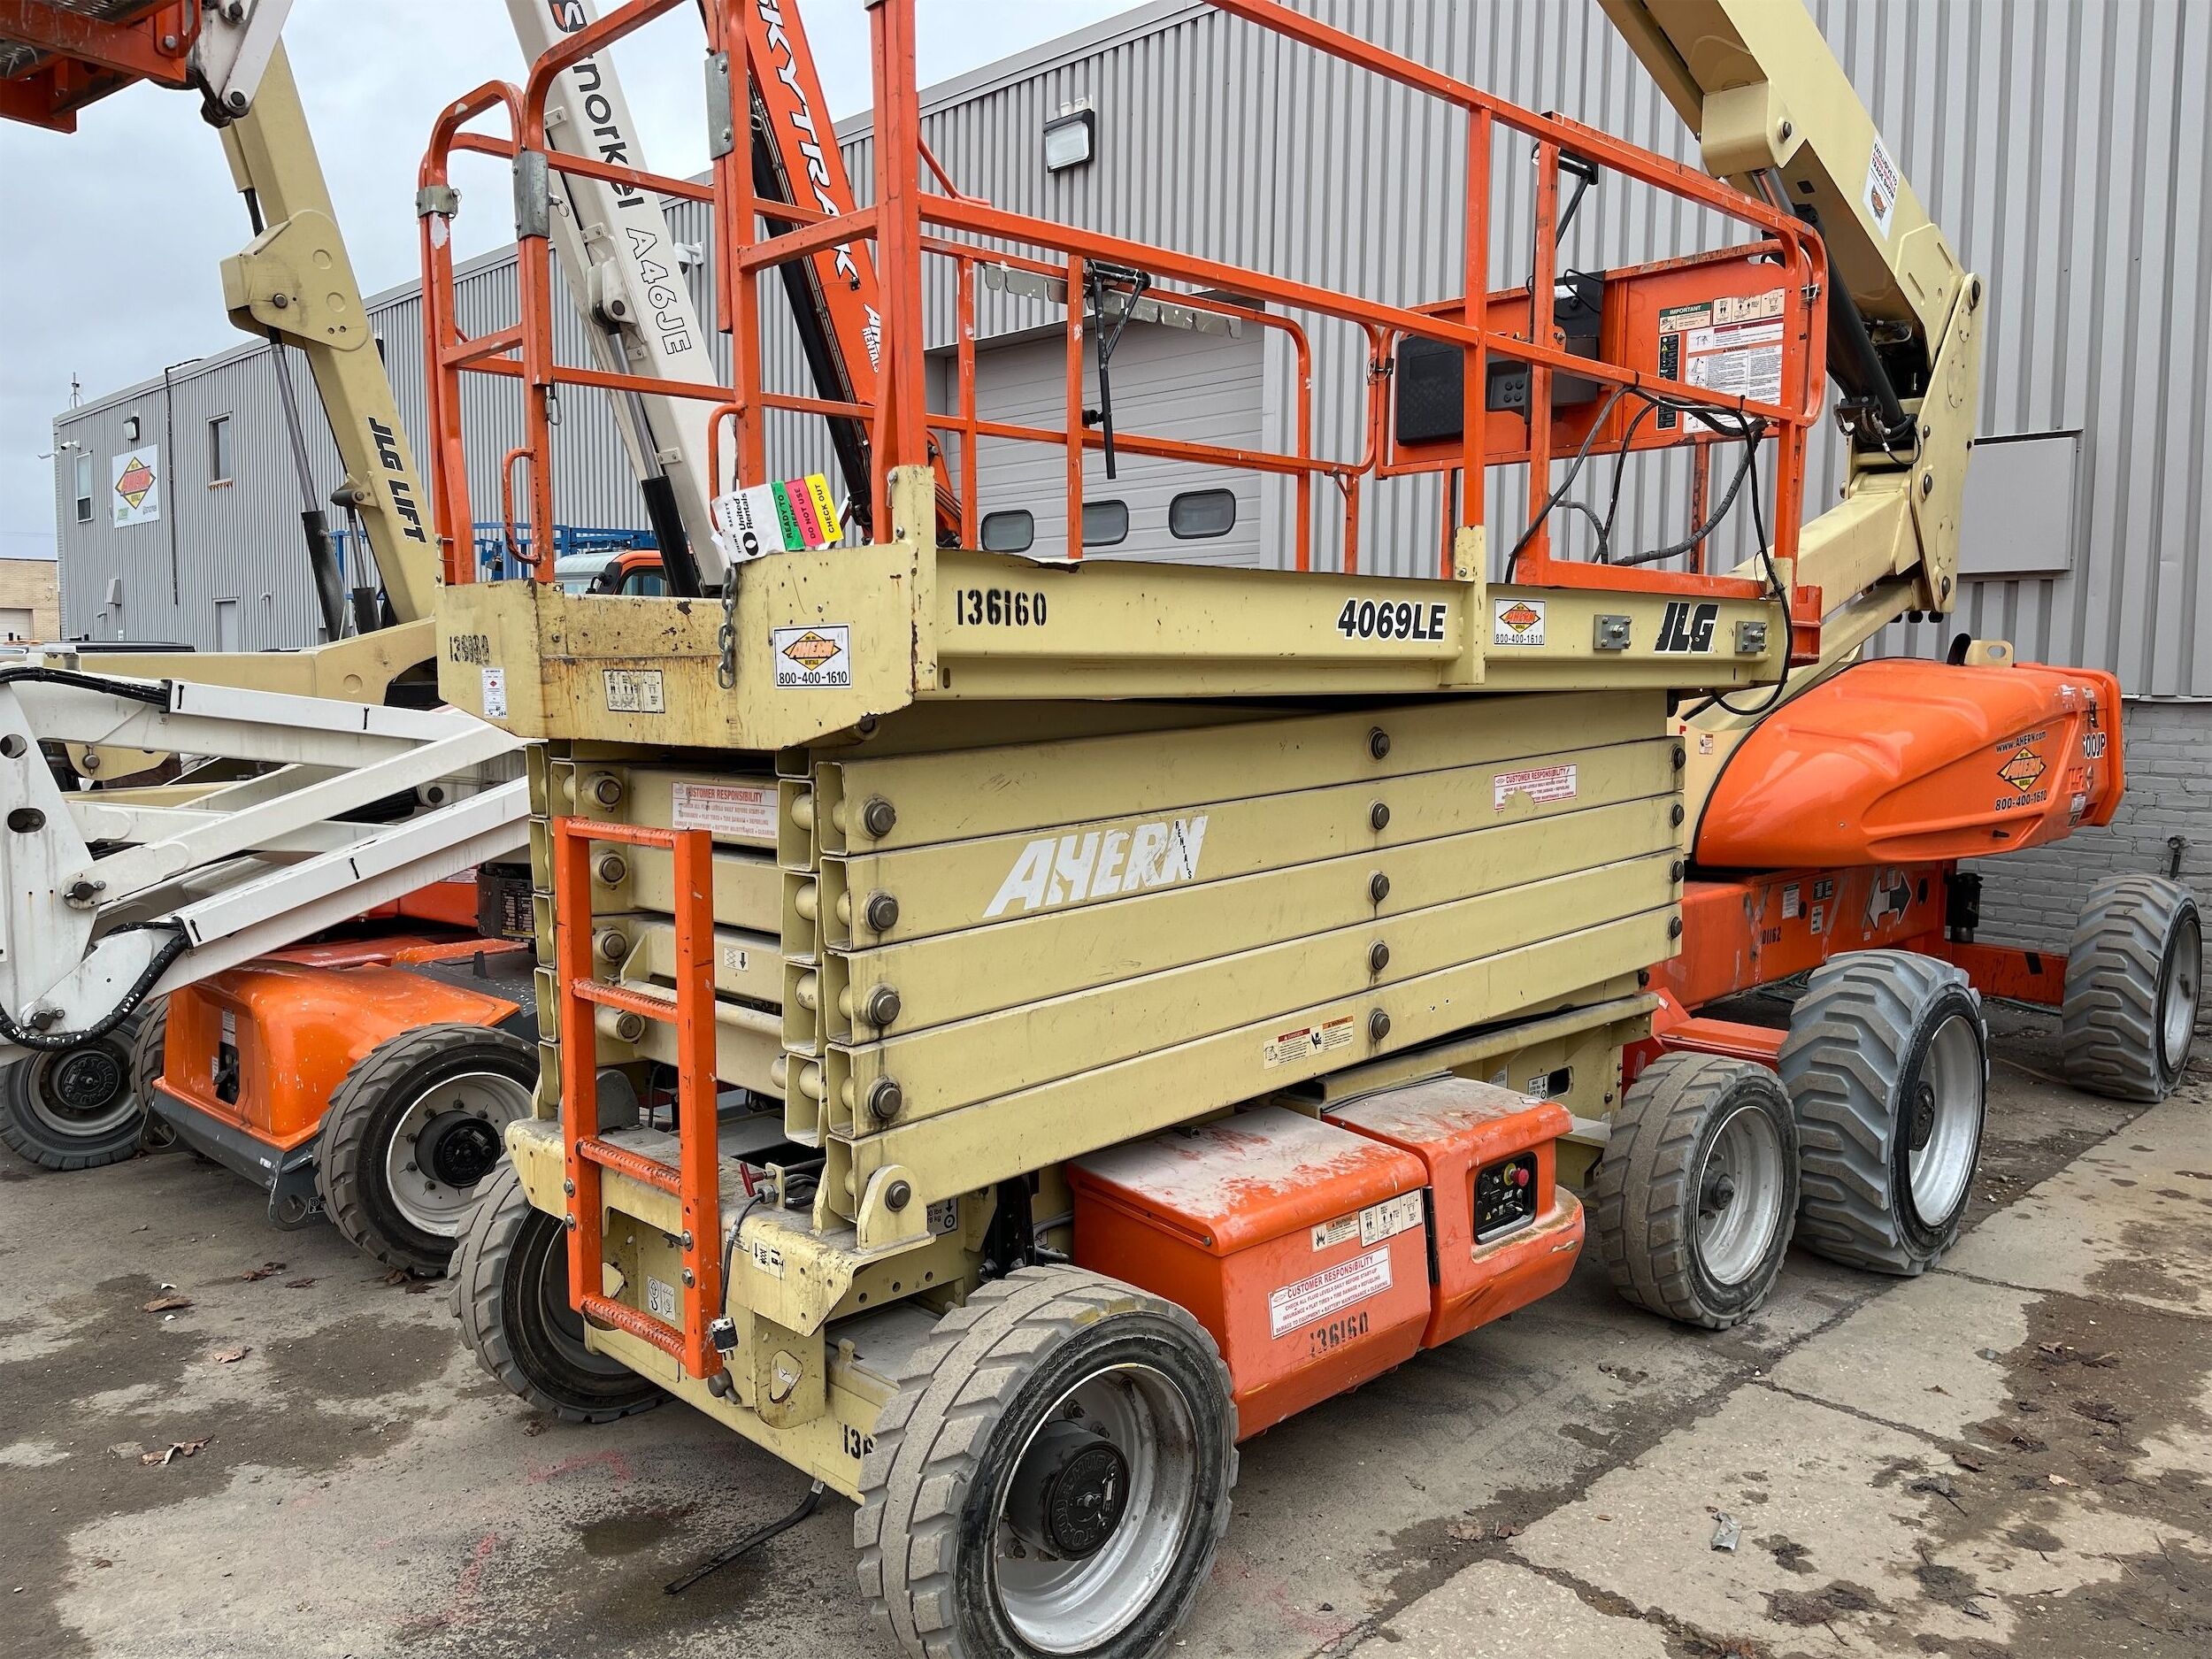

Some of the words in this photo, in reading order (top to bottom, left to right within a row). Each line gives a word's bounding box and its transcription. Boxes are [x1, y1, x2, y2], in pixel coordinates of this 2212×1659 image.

[572, 53, 645, 209] norkel
[626, 227, 693, 356] A46JE
[1669, 305, 1701, 315] IMPORTANT
[367, 416, 405, 471] JLG
[388, 479, 427, 543] LIFT
[778, 495, 787, 508] TO
[795, 488, 804, 506] USE
[814, 483, 826, 502] OUT
[725, 503, 733, 526] SAFETY
[733, 497, 746, 530] United
[741, 494, 754, 528] Rentals
[801, 507, 811, 527] NOT
[819, 504, 834, 534] CHECK
[780, 509, 794, 539] READY
[807, 528, 816, 540] DO
[733, 533, 741, 554] THINK
[957, 589, 1047, 626] 136160
[1337, 599, 1448, 641] 4069LE
[1654, 602, 1719, 652] JLG
[1496, 634, 1543, 644] 800-400-1610
[779, 671, 848, 684] 800-400-1610
[1995, 731, 2047, 752] www.AHERN.com
[1506, 772, 1531, 784] CUSTOMER
[1532, 768, 1567, 780] RESPONSIBILITY
[686, 787, 716, 800] CUSTOMER
[717, 789, 764, 803] RESPONSIBILITY
[1995, 790, 2047, 811] 800-400-1610
[1175, 819, 1192, 879] RENTALS
[982, 815, 1209, 918] AHERN
[1287, 1277, 1324, 1299] CUSTOMER
[1324, 1256, 1374, 1284] RESPONSIBILITY
[1285, 1301, 1299, 1311] CHECK
[1308, 1293, 1319, 1304] FLUID
[1319, 1286, 1334, 1300] LEVELS
[1334, 1282, 1345, 1293] DAILY
[1360, 1268, 1378, 1281] START-UP
